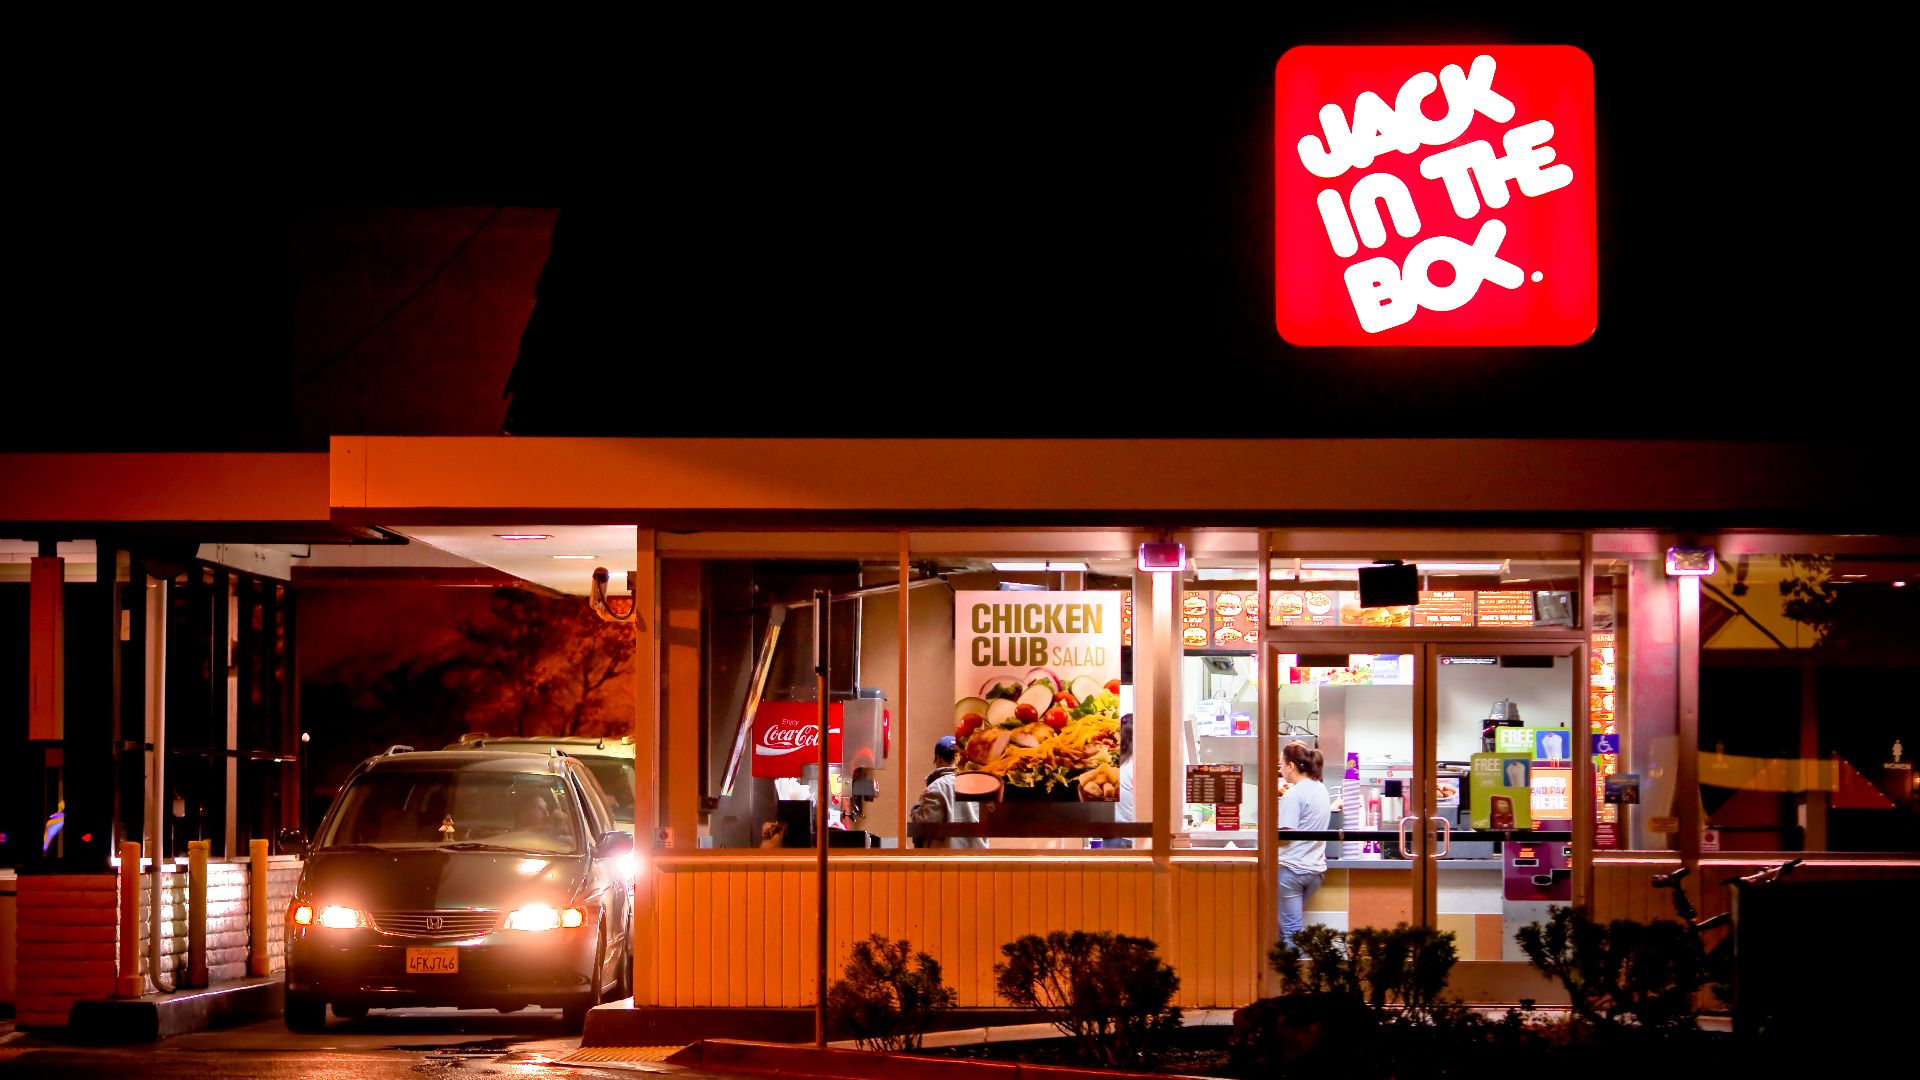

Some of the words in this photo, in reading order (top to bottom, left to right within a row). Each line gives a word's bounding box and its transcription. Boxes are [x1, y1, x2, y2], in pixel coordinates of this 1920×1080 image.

[1297, 54, 1516, 178] JACK
[1419, 119, 1574, 219] THE
[971, 603, 1103, 634] CHICKEN
[971, 636, 1049, 667] CLUB
[1052, 646, 1106, 667] SALAD
[782, 718, 800, 726] Enjoy
[763, 724, 819, 747] Coca-Col
[1501, 728, 1534, 744] FREE
[1475, 758, 1501, 772] FREE
[1884, 762, 1912, 770] WOMEN
[410, 956, 455, 971] 4FKJ746
